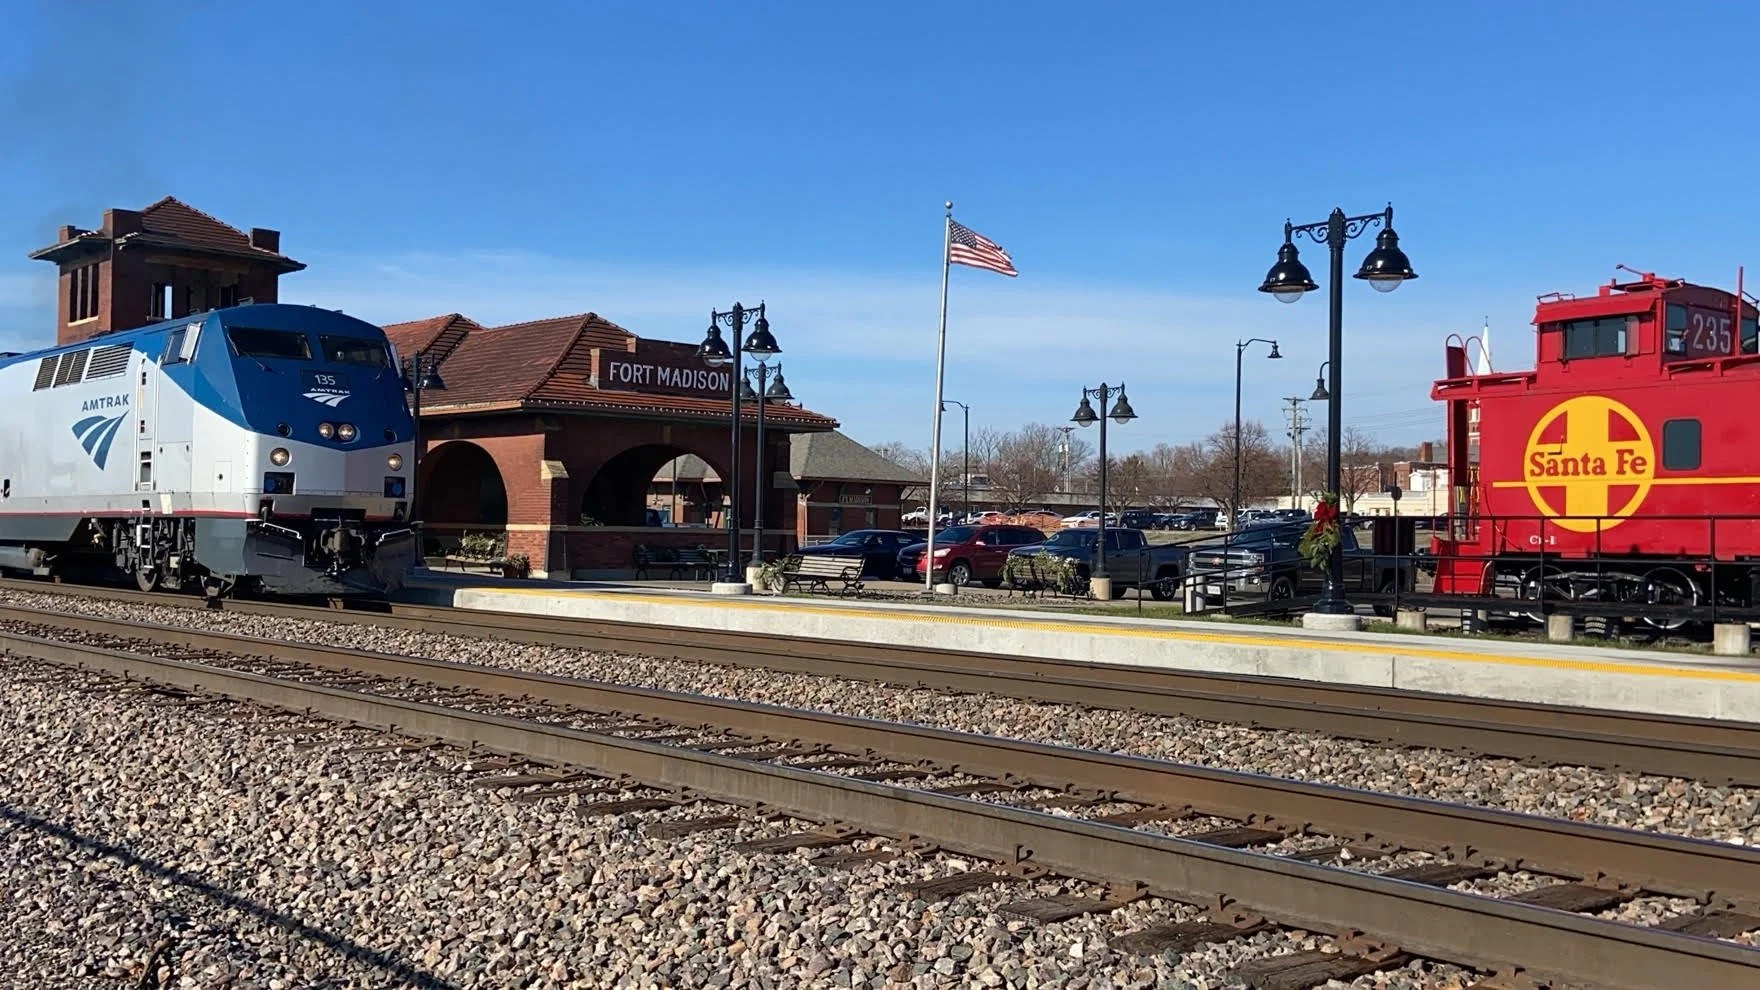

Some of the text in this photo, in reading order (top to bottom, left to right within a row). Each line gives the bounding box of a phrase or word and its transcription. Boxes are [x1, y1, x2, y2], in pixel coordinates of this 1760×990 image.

[1692, 313, 1731, 353] 235
[314, 374, 336, 385] 135
[609, 361, 729, 391] FORT MADISON
[81, 393, 129, 412] AMTRAK
[1529, 449, 1647, 477] Santa Fe
